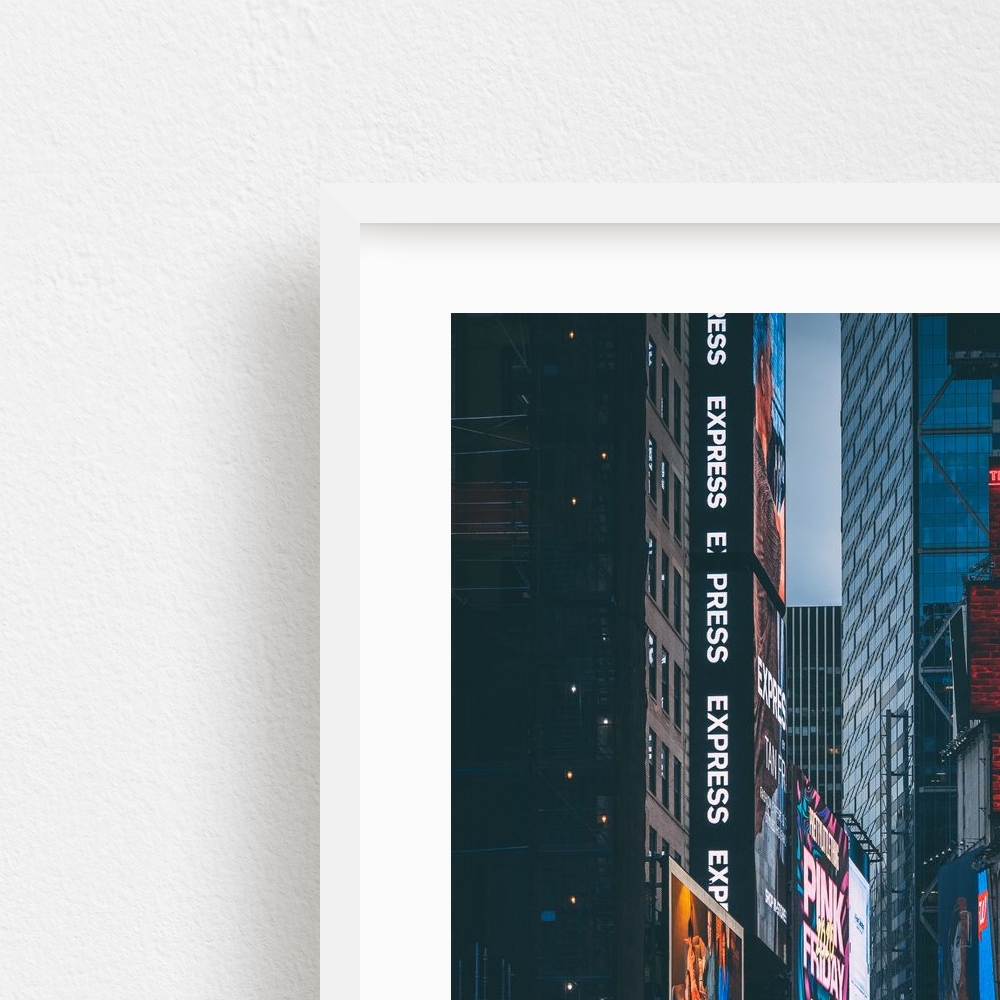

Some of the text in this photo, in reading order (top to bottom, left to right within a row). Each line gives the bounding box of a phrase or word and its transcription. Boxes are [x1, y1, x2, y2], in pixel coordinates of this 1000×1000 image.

[706, 395, 727, 509] EXPRESS
[707, 695, 729, 825] EXPRESS
[803, 845, 845, 956] PINK
